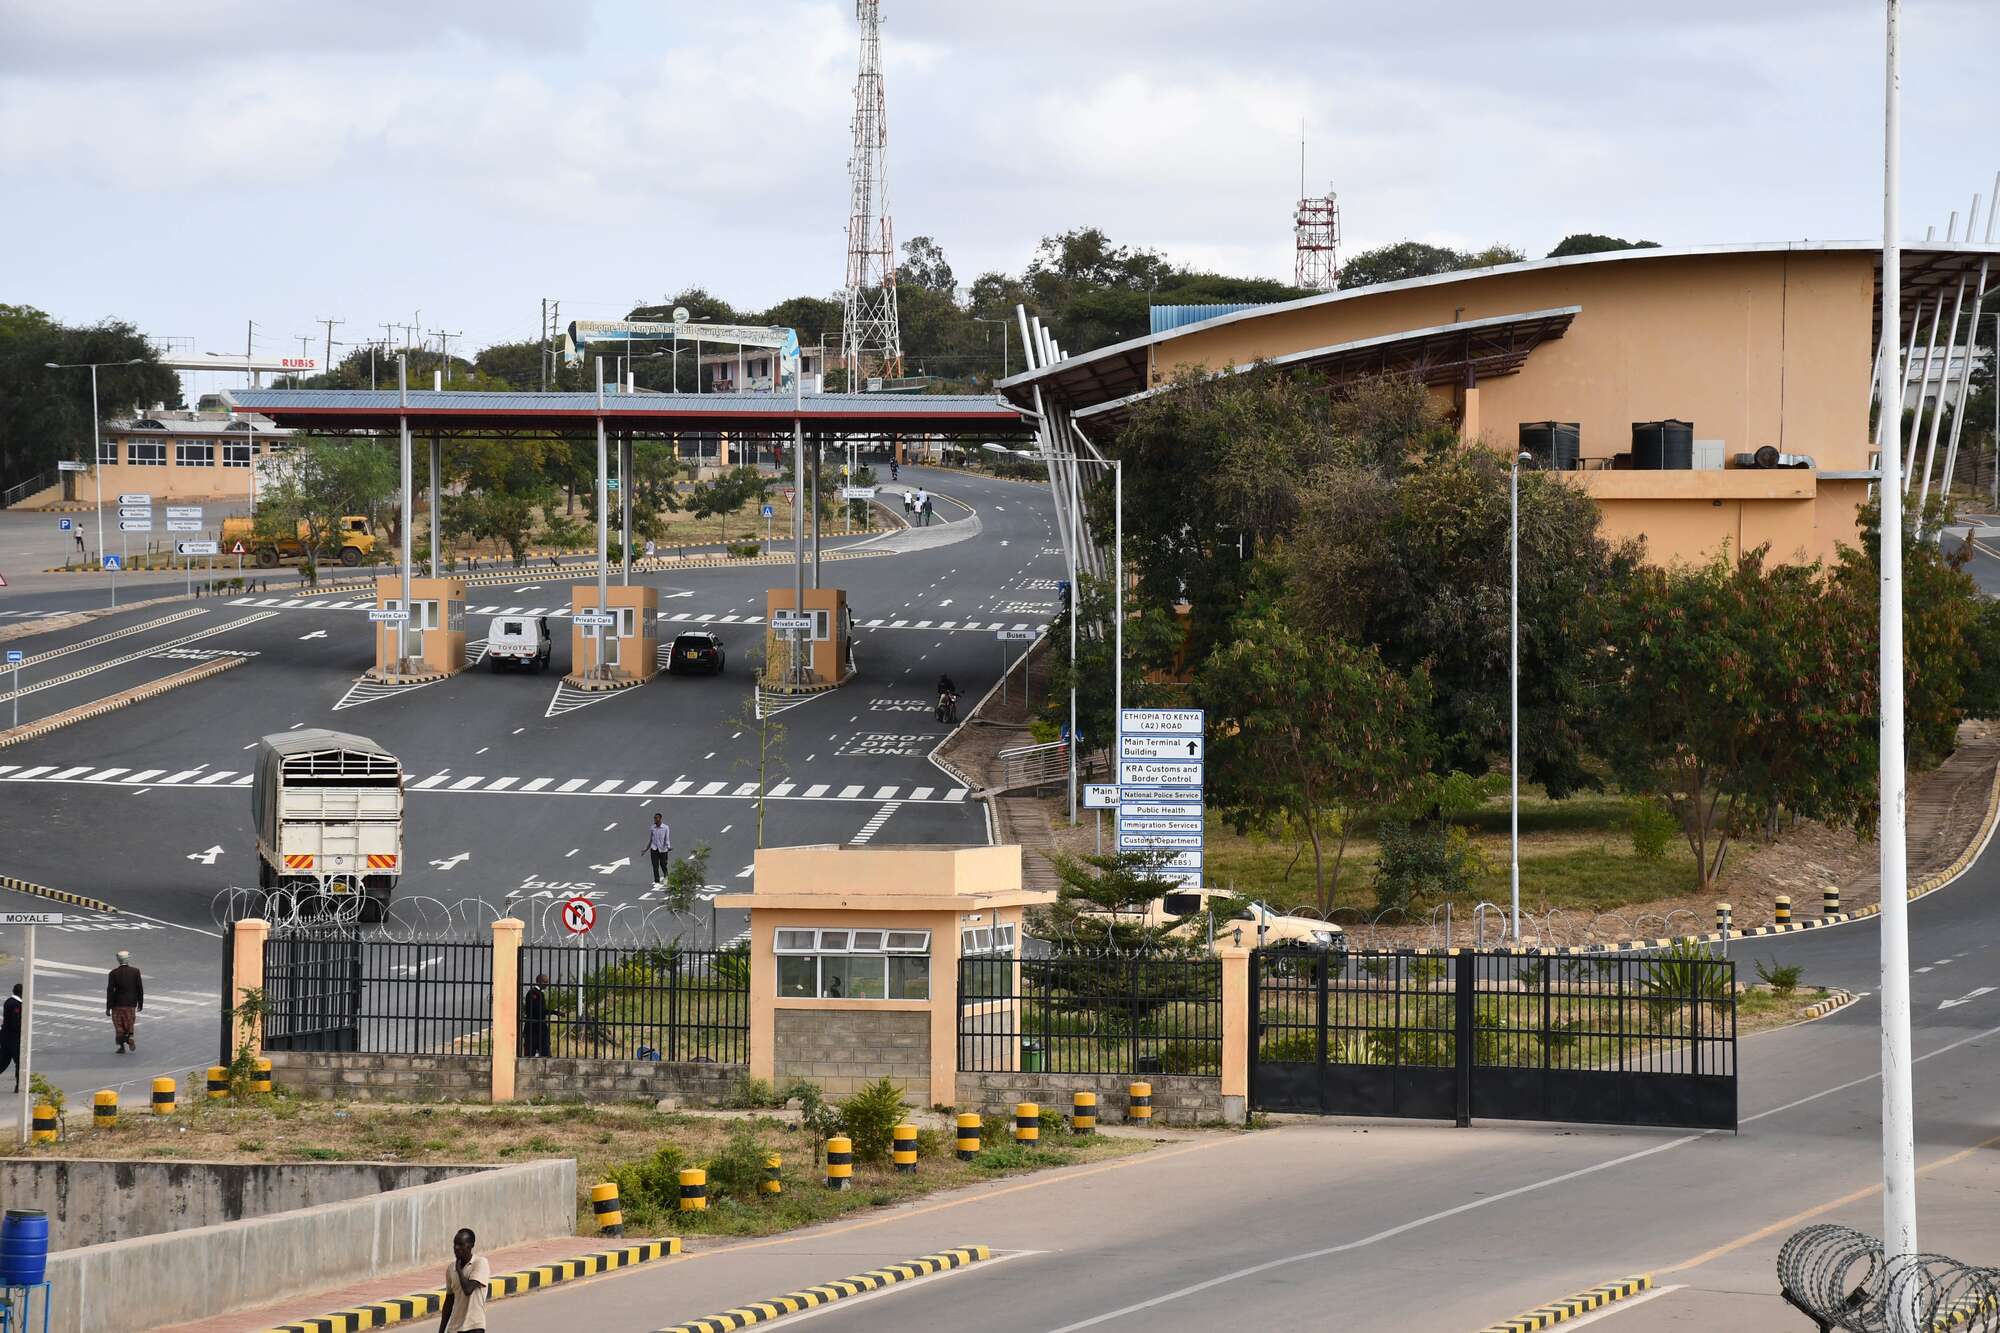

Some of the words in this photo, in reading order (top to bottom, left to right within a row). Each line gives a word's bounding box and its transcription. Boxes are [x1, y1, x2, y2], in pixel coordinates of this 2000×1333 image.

[631, 324, 658, 335] Kenya
[659, 324, 693, 334] Marbit
[62, 520, 69, 529] P
[520, 882, 596, 890] BUS
[505, 890, 608, 900] LANE
